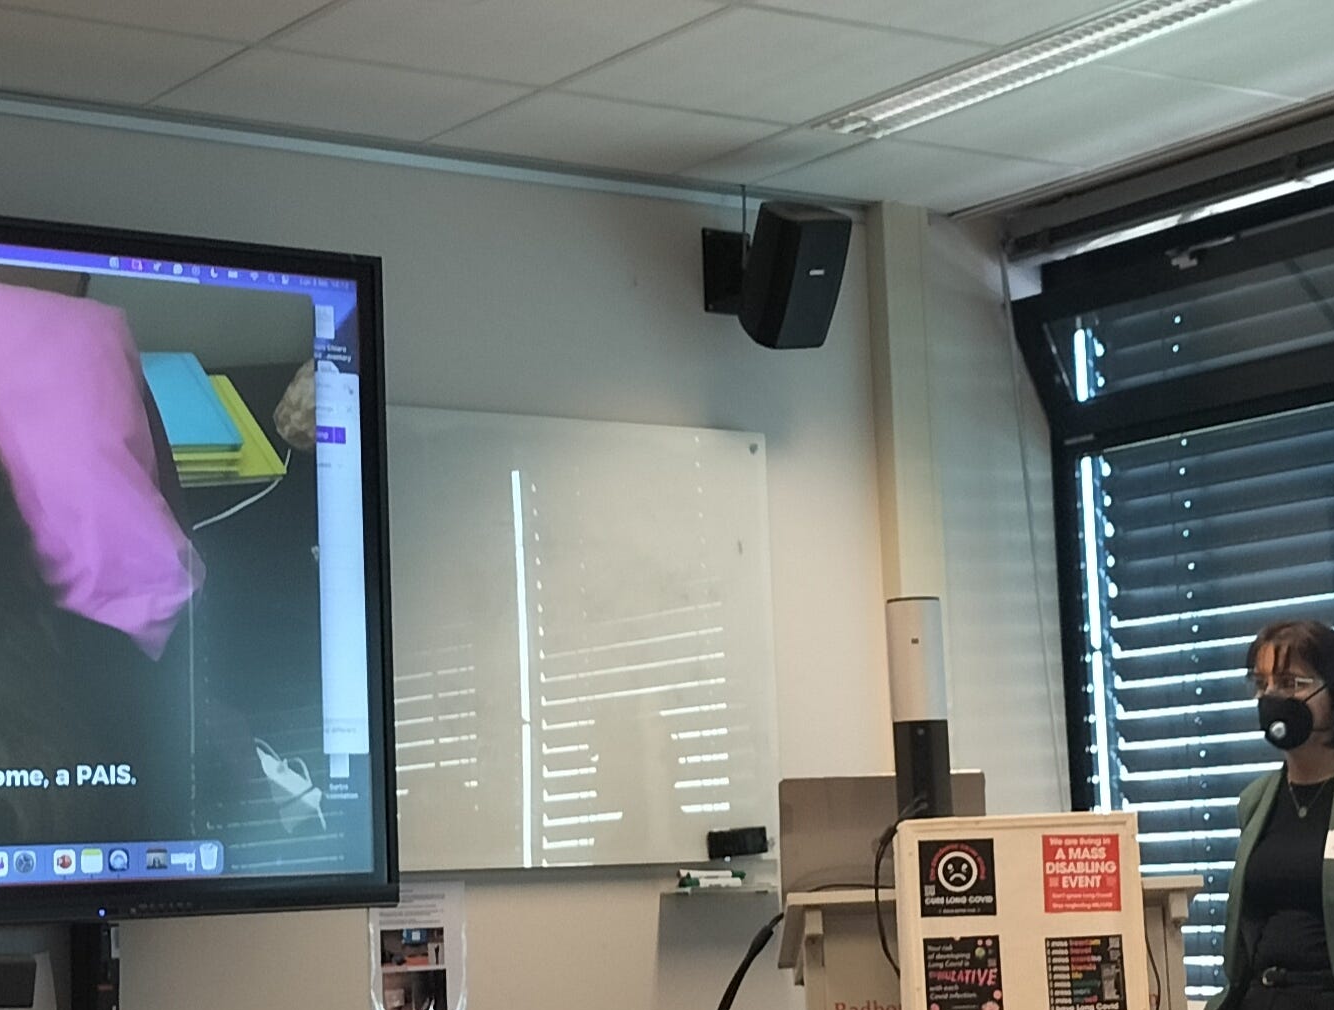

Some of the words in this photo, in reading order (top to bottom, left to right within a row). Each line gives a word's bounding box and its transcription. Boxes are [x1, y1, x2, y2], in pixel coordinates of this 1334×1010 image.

[55, 767, 70, 788] a
[76, 763, 138, 787] PAIS.
[1064, 838, 1078, 846] are
[1079, 837, 1102, 847] living
[1054, 847, 1066, 860] A
[1068, 846, 1107, 860] MASS
[1045, 860, 1117, 875] DISABLING
[1061, 874, 1102, 889] EVENT
[946, 895, 967, 905] LONG
[968, 894, 994, 904] COVID
[1096, 1002, 1119, 1010] Covid
